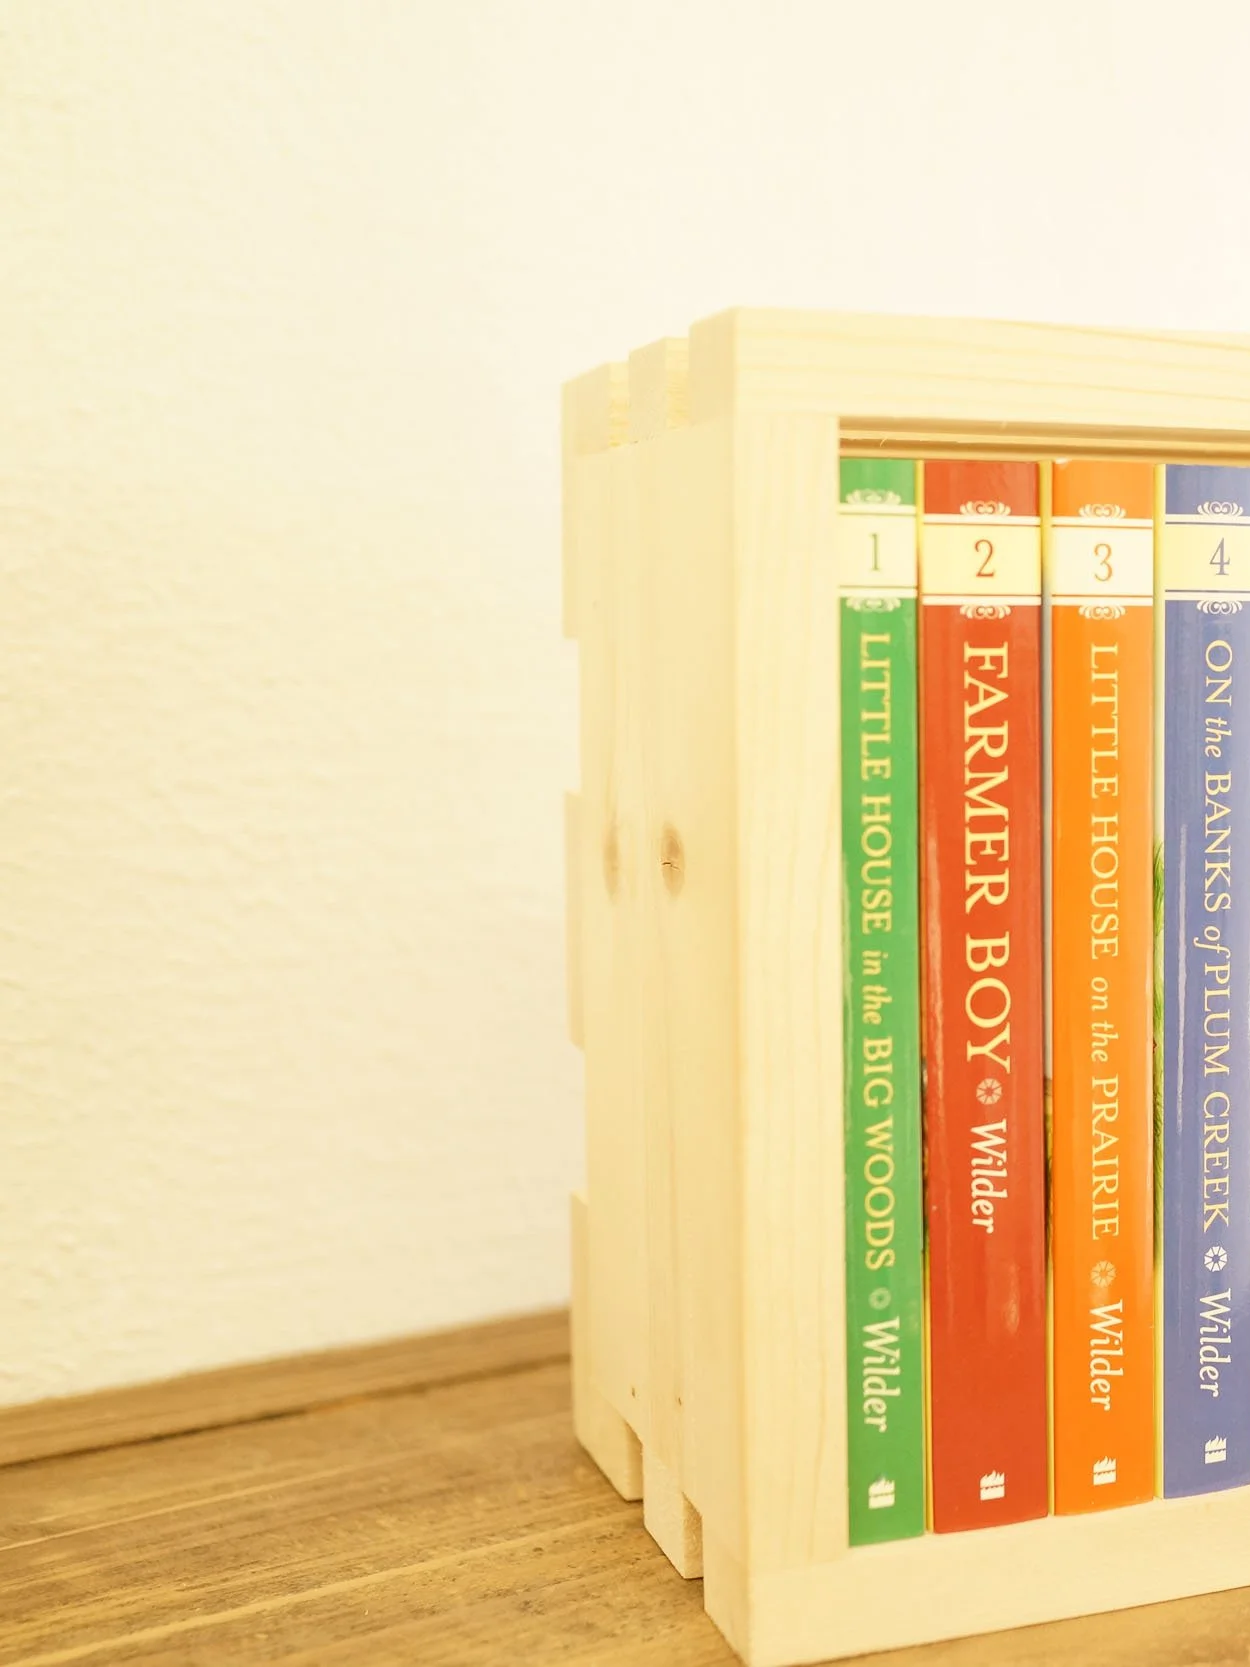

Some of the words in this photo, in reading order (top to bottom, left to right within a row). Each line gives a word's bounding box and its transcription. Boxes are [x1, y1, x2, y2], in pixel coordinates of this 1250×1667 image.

[869, 533, 880, 572] 1
[974, 539, 995, 578] 2
[1094, 543, 1113, 581] 3
[1209, 537, 1230, 576] 4
[860, 632, 891, 780] LITTLE
[1090, 643, 1118, 799] LITTLE
[1205, 639, 1233, 706] ON
[963, 641, 1010, 914] FARMER
[1204, 716, 1231, 758] the
[861, 794, 892, 934] HOUSE
[1090, 814, 1118, 960] HOUSE
[1204, 771, 1231, 911] BANKS
[863, 950, 881, 975] in
[1091, 977, 1110, 1011] on
[1193, 925, 1231, 958] of
[862, 984, 892, 1025] the
[965, 933, 1011, 1074] BOY
[1091, 1020, 1119, 1062] the
[1203, 964, 1231, 1075] PLUM
[863, 1037, 893, 1106] BIG
[864, 1120, 895, 1270] WOODS
[969, 1120, 1008, 1234] Wilder
[1091, 1075, 1120, 1241] PRAIRIE
[1202, 1091, 1230, 1233] CREEK
[862, 1318, 900, 1432] Wilder
[1090, 1299, 1124, 1410] Wilder
[1199, 1288, 1231, 1397] Wilder
